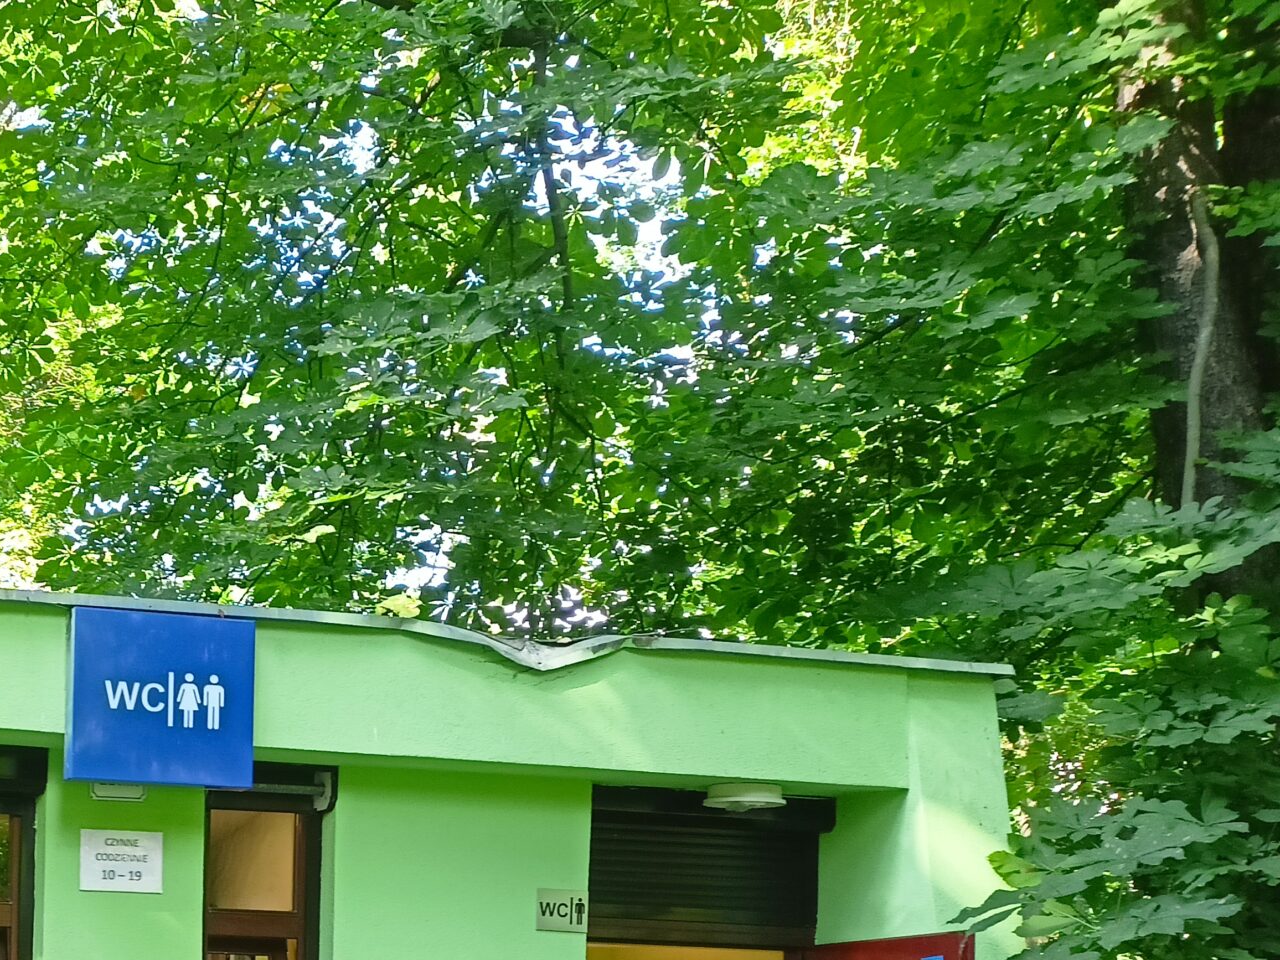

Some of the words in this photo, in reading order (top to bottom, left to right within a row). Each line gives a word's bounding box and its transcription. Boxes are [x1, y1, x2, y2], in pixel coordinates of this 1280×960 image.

[104, 679, 166, 713] WC
[101, 869, 116, 880] 10
[128, 870, 143, 881] 19
[539, 901, 569, 918] WC
